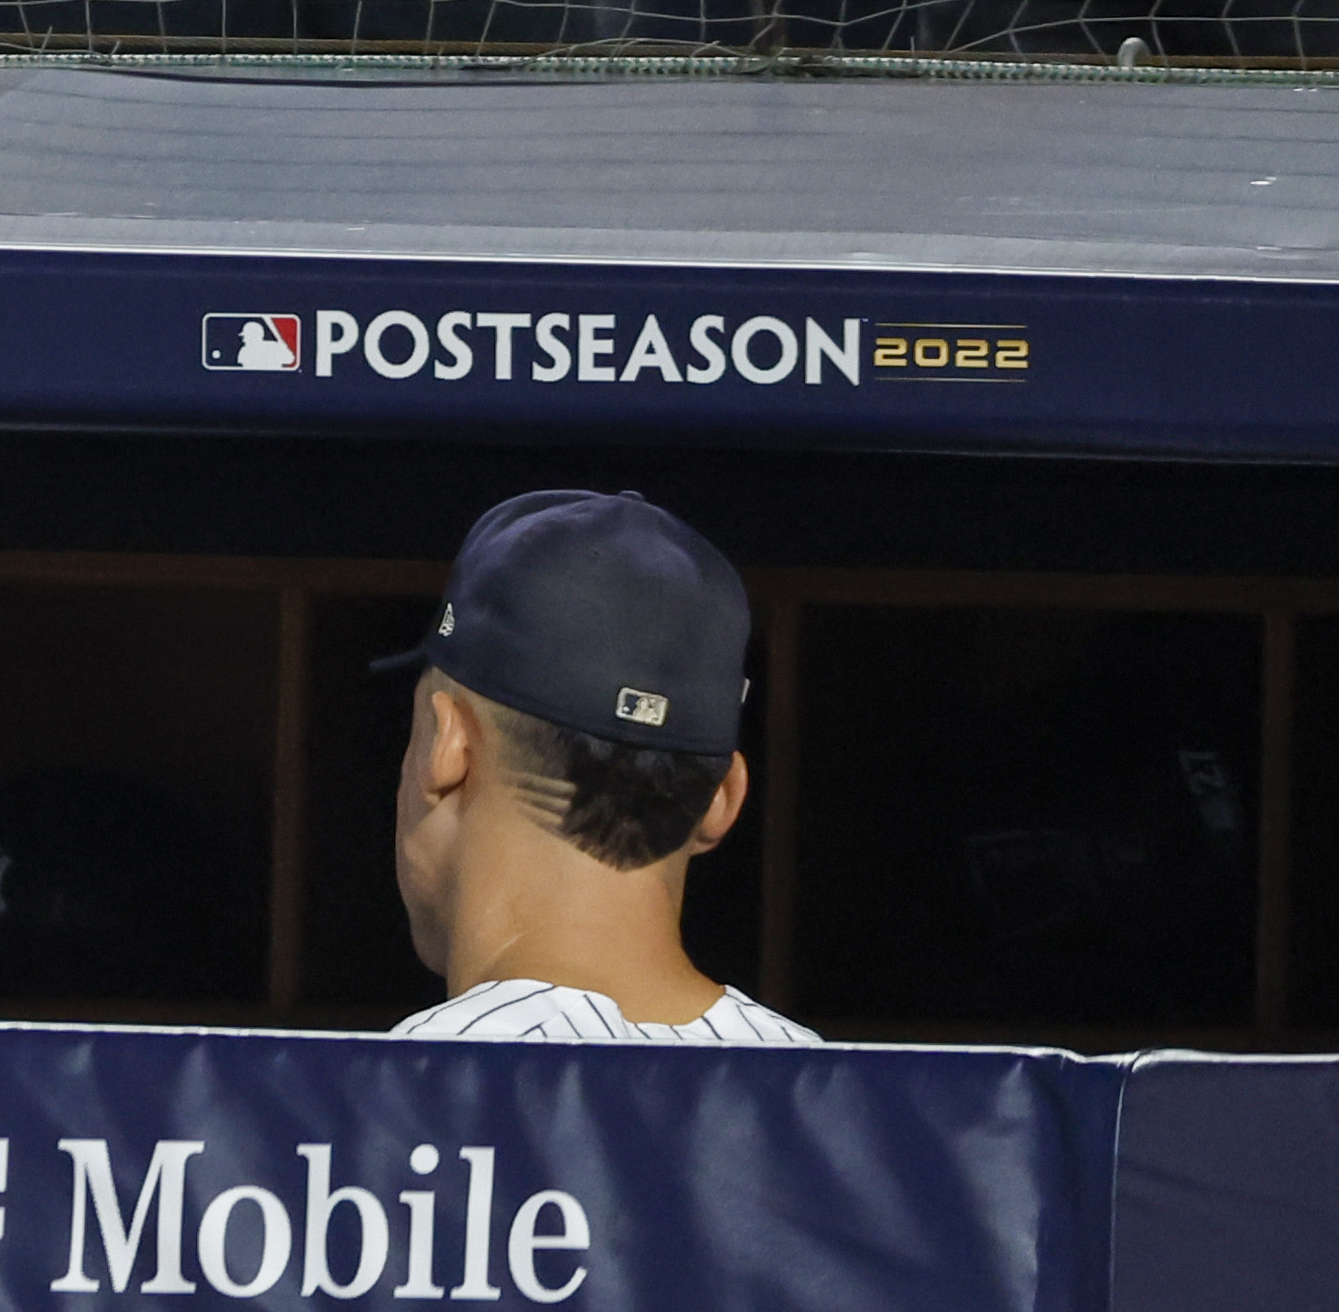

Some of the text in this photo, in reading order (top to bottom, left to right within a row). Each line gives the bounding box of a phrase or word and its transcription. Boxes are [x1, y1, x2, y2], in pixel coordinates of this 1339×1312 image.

[314, 309, 1030, 386] POSTSEASON 2022
[49, 1139, 592, 1304] Mobile
